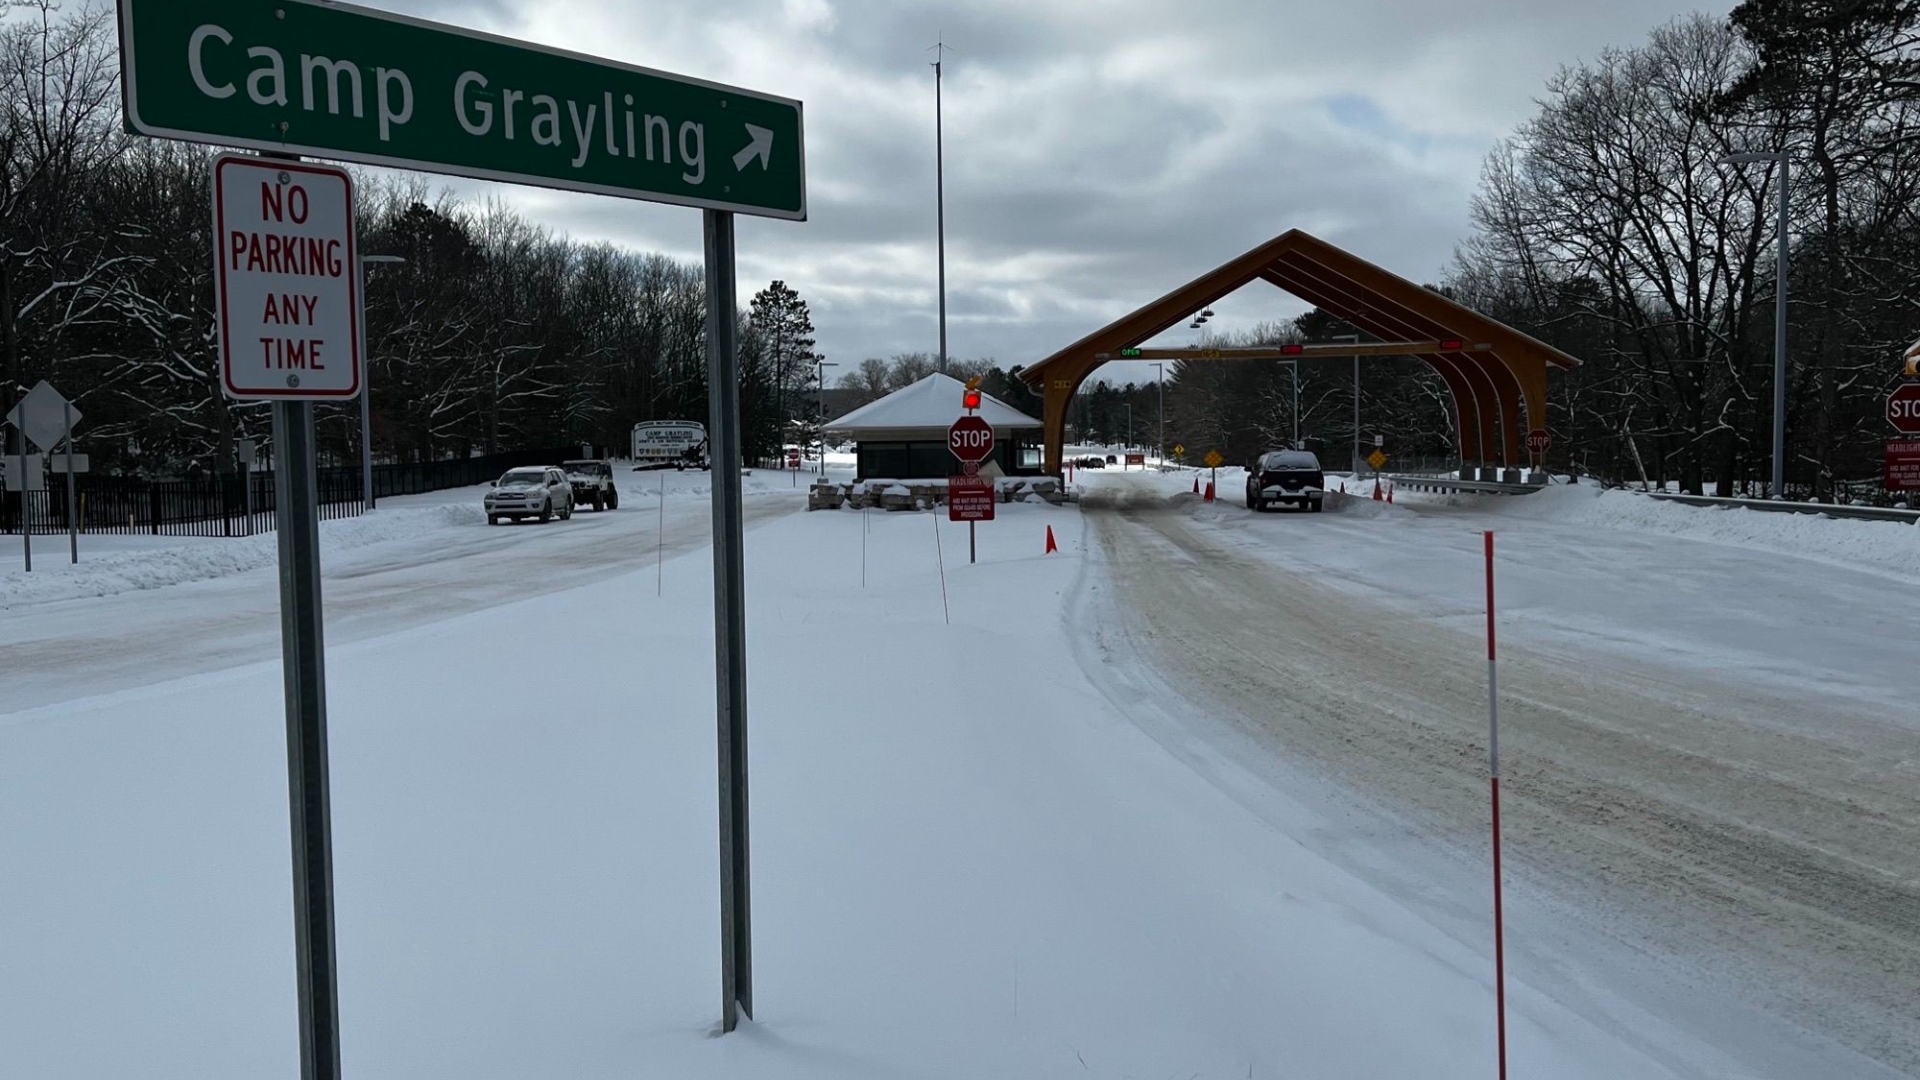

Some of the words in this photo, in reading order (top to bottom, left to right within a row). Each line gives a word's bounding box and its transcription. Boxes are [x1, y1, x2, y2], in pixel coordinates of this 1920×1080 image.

[188, 24, 414, 141] Camp
[454, 70, 706, 185] Grayling
[262, 181, 308, 224] NO
[231, 230, 342, 278] PARKING
[263, 293, 318, 326] ANY
[260, 338, 325, 370] TIME
[1121, 348, 1140, 356] OPEN
[952, 430, 990, 447] STOP
[1527, 436, 1549, 447] STOP
